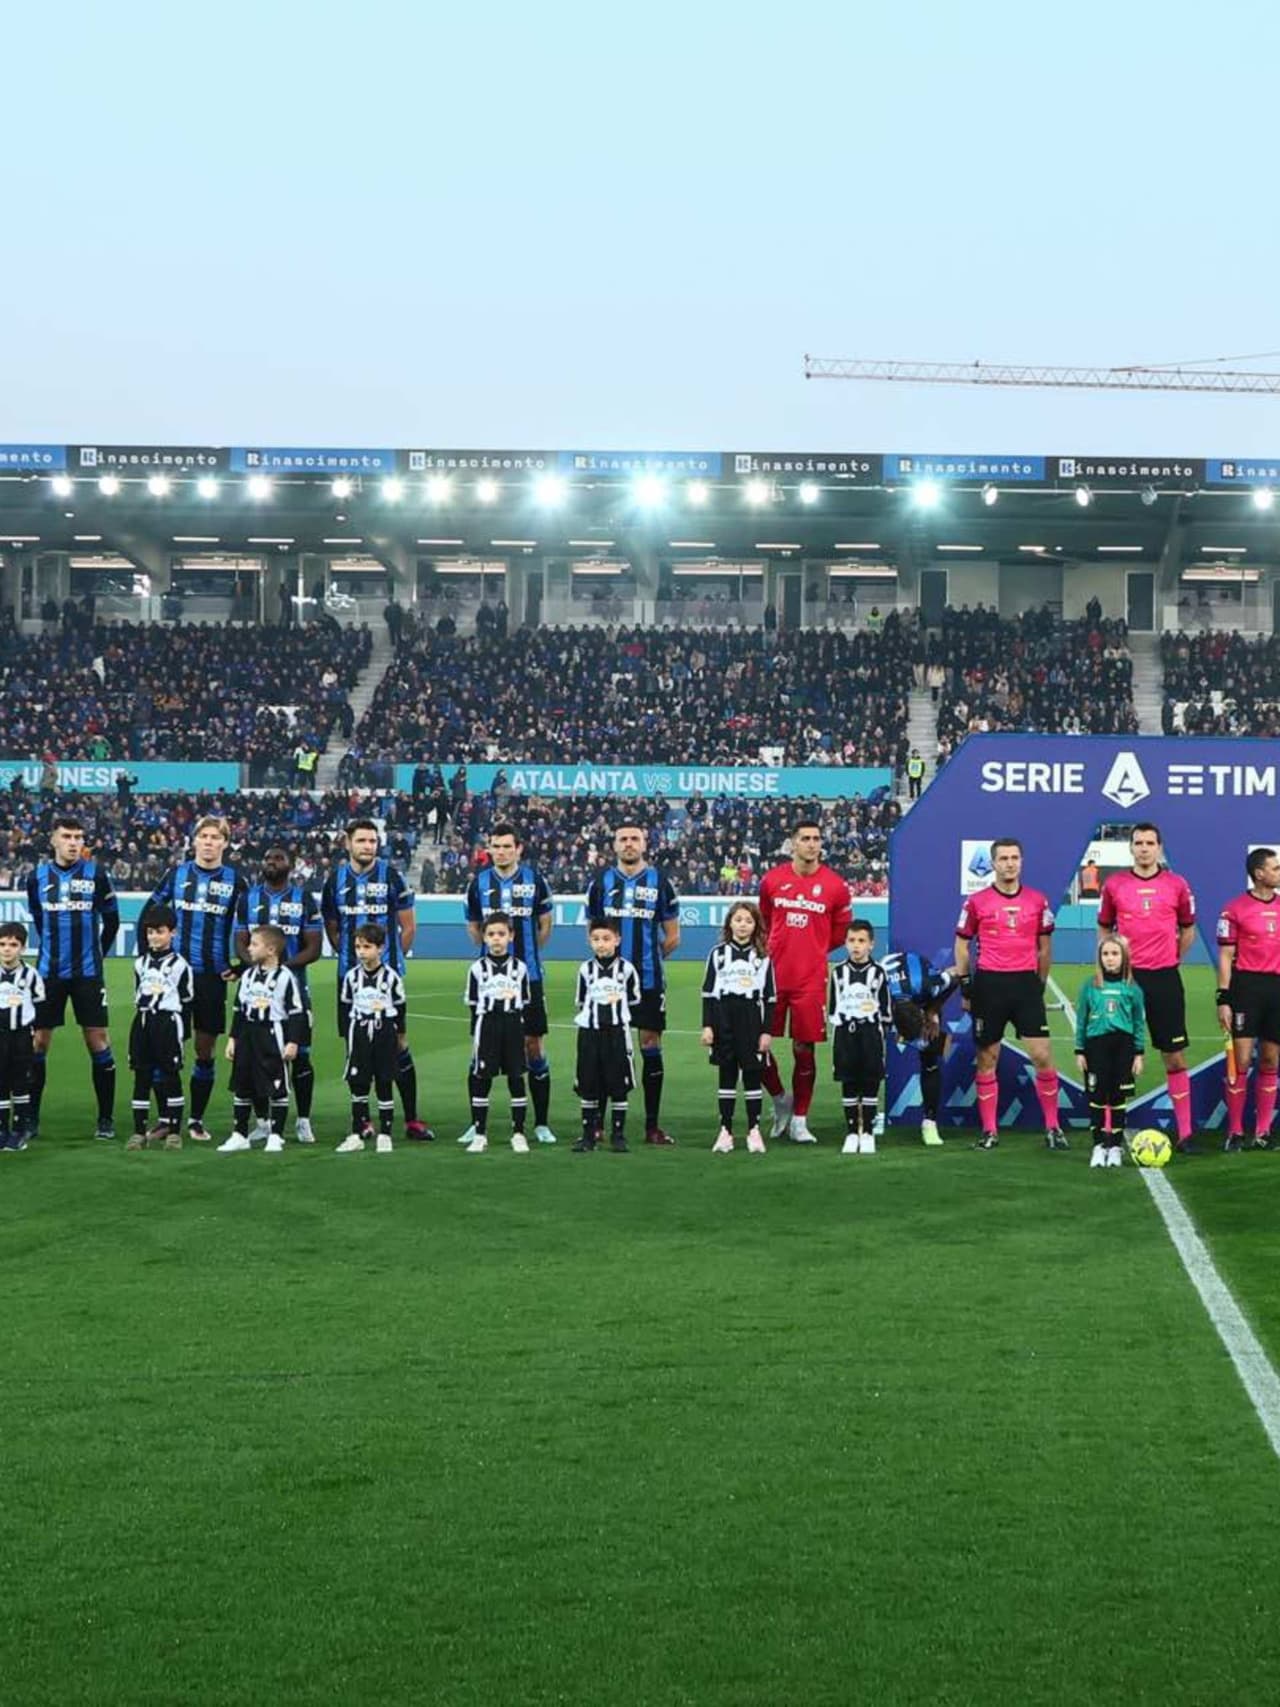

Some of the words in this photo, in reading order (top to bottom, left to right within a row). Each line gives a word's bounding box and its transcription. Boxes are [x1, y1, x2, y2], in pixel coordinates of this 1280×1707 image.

[80, 448, 218, 466] Rinascimento
[247, 452, 382, 467] Rinascimento
[409, 452, 545, 470] Rinascimento
[735, 455, 870, 473] Rinascimento
[900, 460, 1032, 474] Rinascimento
[1059, 459, 1193, 477] Rinascimento
[511, 770, 638, 791] ATALANTA
[679, 772, 779, 793] UDINESE
[981, 762, 1085, 793] SERIE
[1210, 765, 1276, 796] TIM
